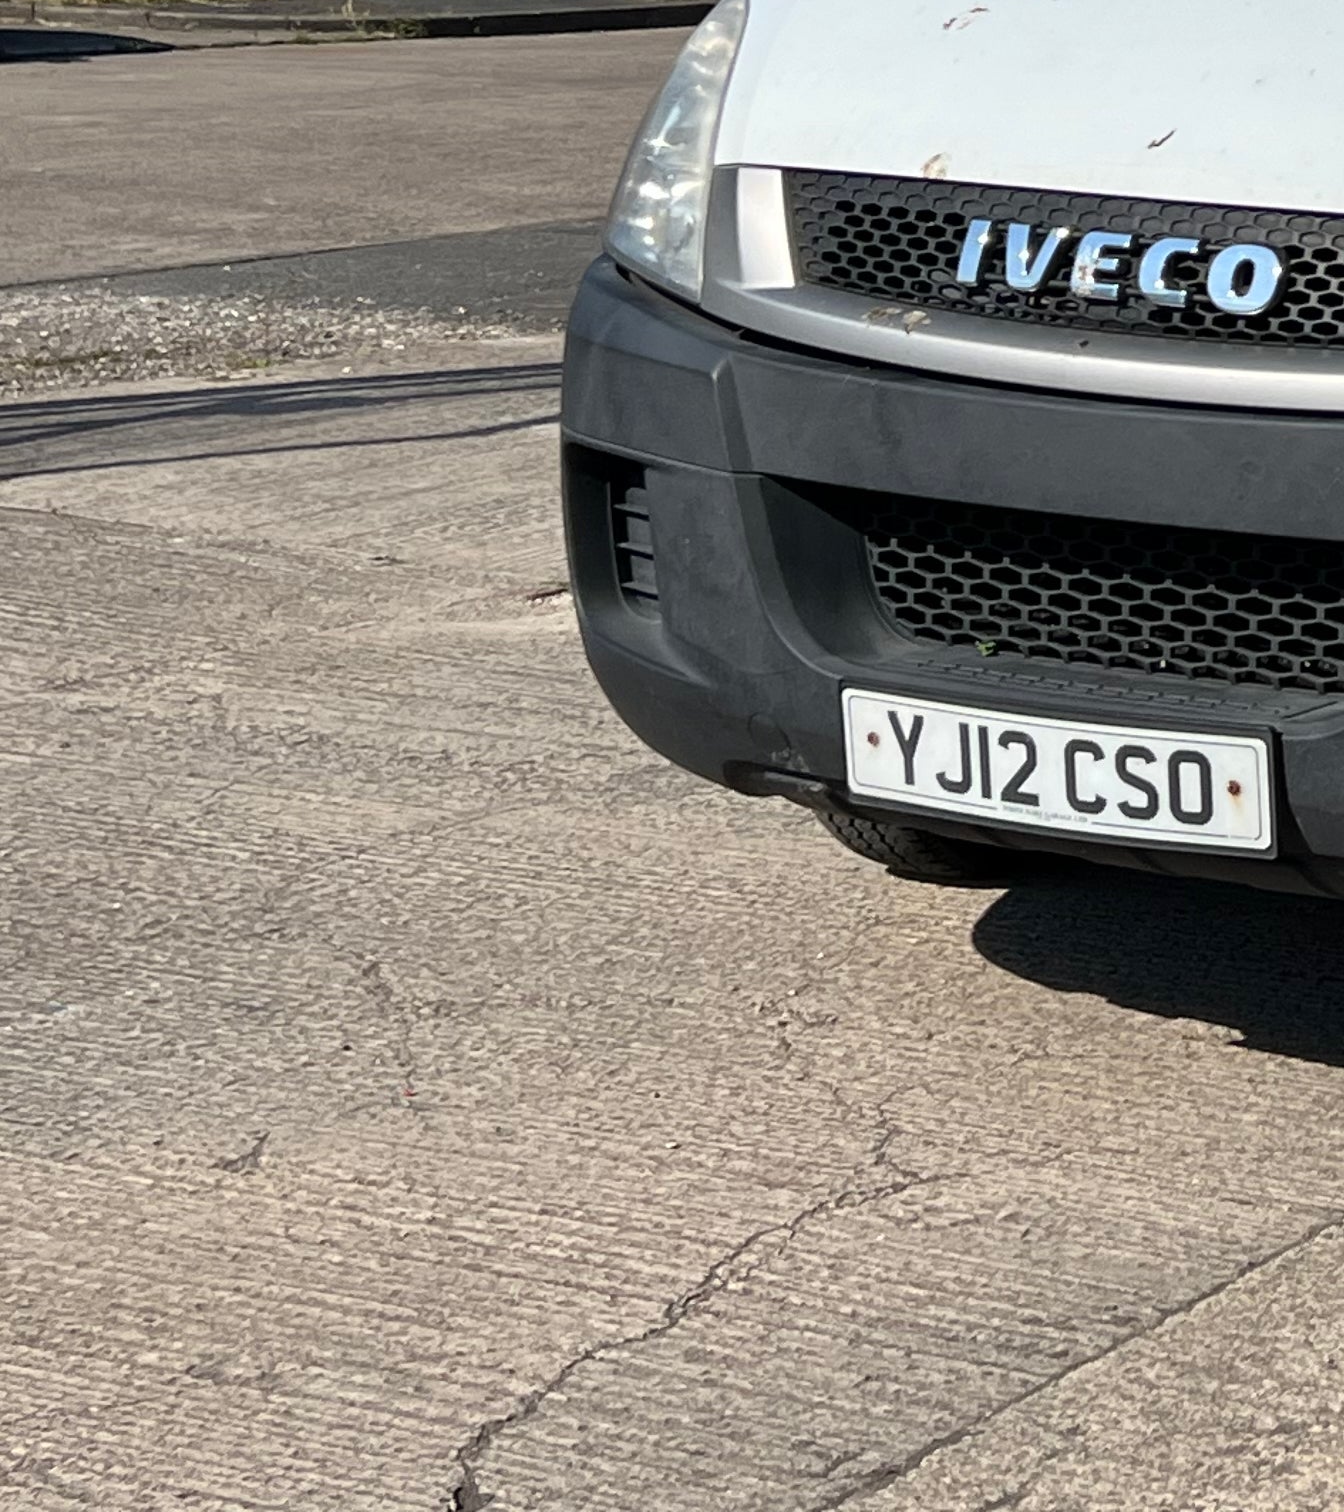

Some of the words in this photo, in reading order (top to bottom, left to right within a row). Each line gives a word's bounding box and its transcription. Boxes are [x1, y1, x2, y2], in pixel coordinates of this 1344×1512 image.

[955, 219, 1284, 315] IVECO
[887, 710, 1040, 807] YJ12
[1064, 738, 1213, 826] CSO
